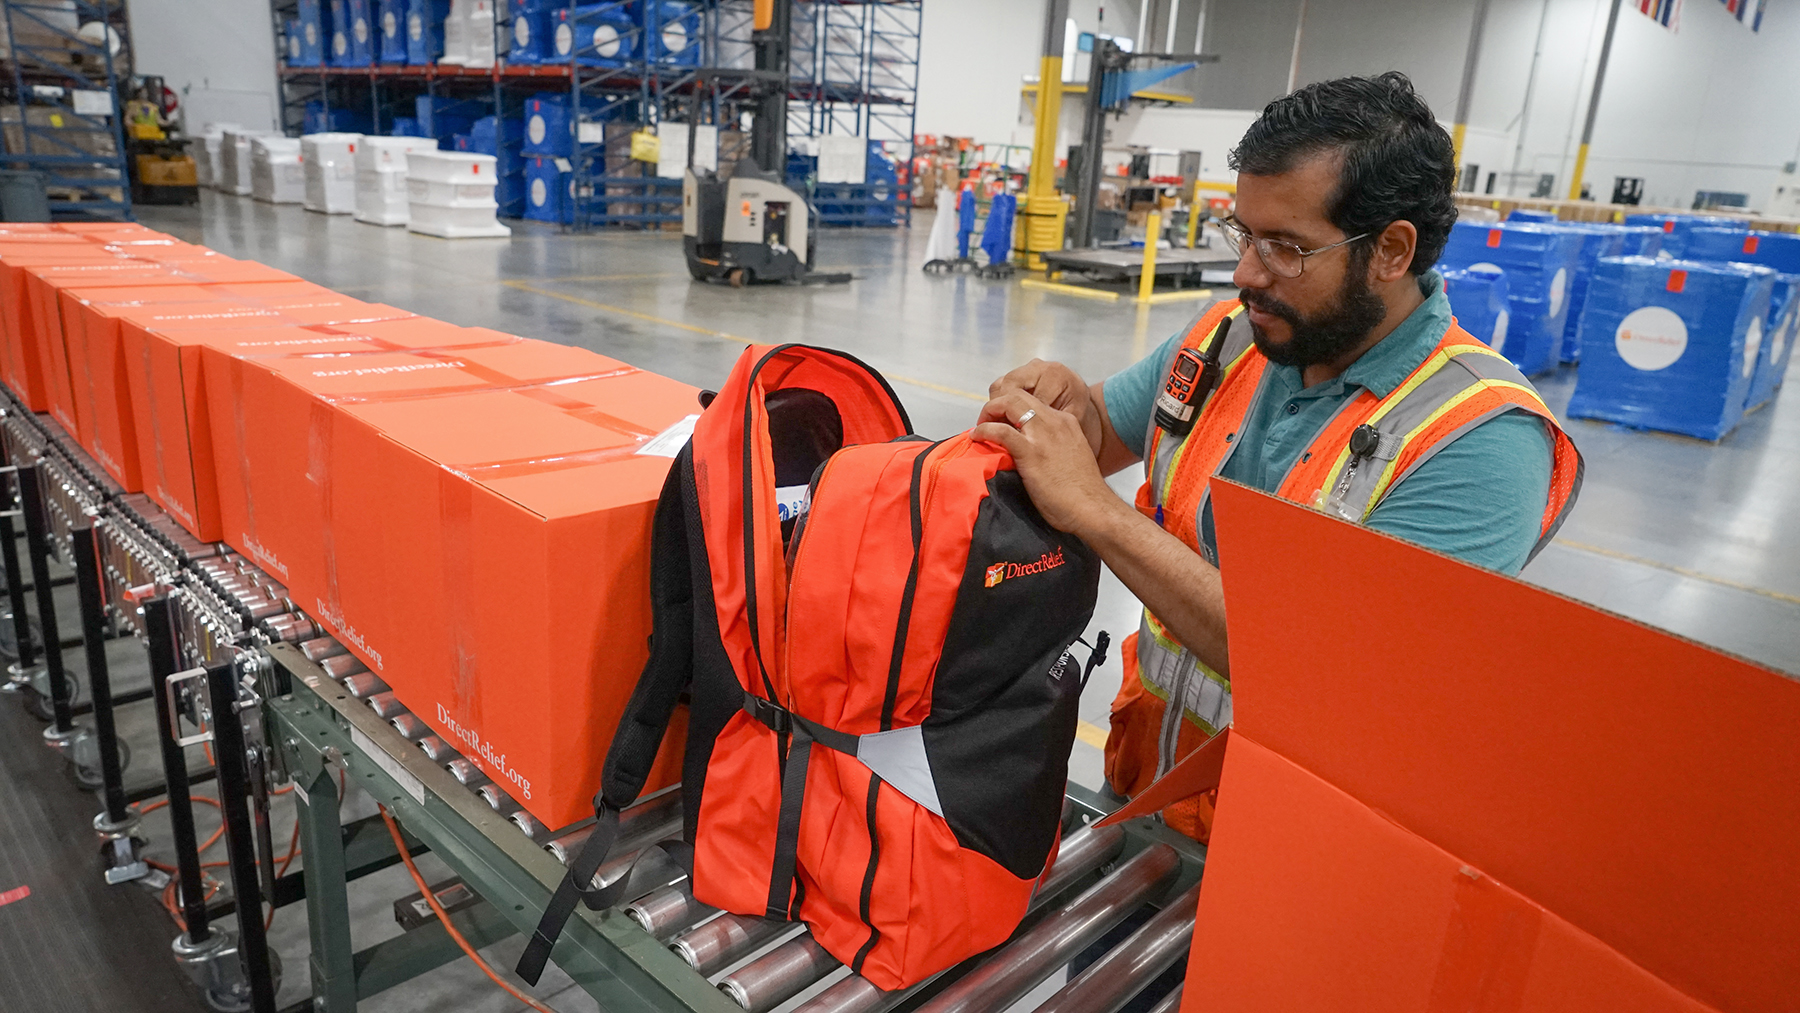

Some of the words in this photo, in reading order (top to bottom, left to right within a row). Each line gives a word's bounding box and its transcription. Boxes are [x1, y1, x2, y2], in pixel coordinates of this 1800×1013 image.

[1006, 545, 1065, 579] DirectRelief
[317, 598, 384, 671] DirectRelief.org
[437, 702, 532, 800] DirectRelief.org
